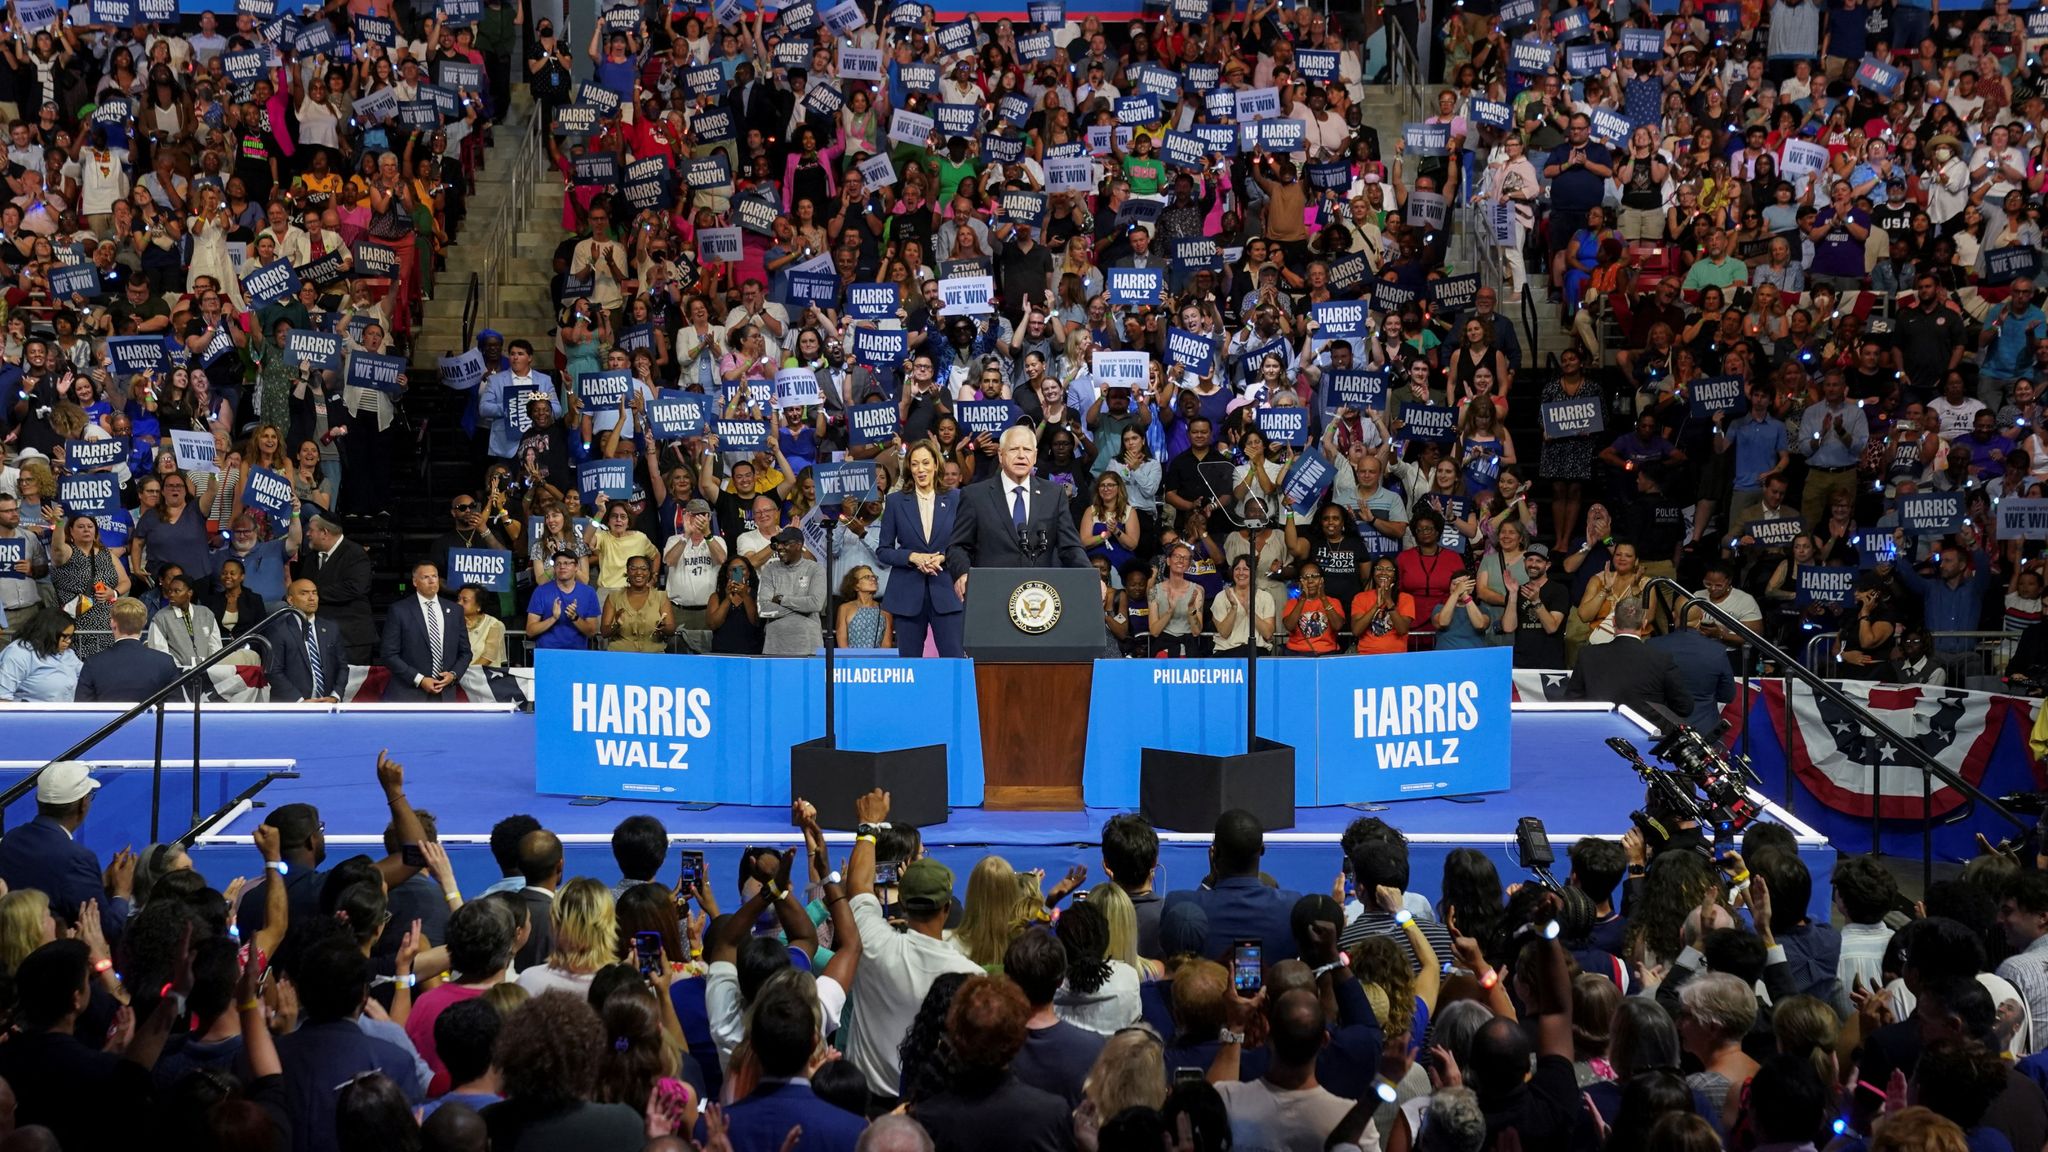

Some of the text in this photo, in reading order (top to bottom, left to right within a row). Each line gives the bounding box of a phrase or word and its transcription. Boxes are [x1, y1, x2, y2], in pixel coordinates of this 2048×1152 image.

[606, 9, 640, 22] HARRIS
[938, 24, 972, 44] HARRIS
[1018, 35, 1051, 52] HARRIS
[1624, 38, 1659, 52] WE WIN
[1025, 48, 1047, 59] WALZ
[1514, 45, 1550, 61] HARRIS
[224, 53, 261, 71] HARRIS
[843, 58, 878, 72] WE WIN
[1299, 55, 1335, 68] HARRIS
[1519, 58, 1543, 69] WALZ
[687, 68, 720, 88] HARRIS
[901, 68, 935, 82] HARRIS
[1188, 67, 1219, 81] HARRIS
[1304, 66, 1329, 77] WALZ
[906, 80, 930, 90] WALZ
[1142, 71, 1178, 88] HARRIS
[1194, 79, 1215, 88] WALZ
[1206, 93, 1234, 108] HARRIS
[1240, 98, 1275, 113] WE WIN
[560, 110, 596, 122] HARRIS
[938, 108, 974, 123] HARRIS
[1475, 103, 1509, 119] HARRIS
[1481, 112, 1504, 125] WALZ
[695, 113, 730, 133] HARRIS
[943, 120, 969, 131] WALZ
[1594, 111, 1629, 132] HARRIS
[703, 127, 727, 139] WALZ
[1262, 123, 1300, 139] HARRIS
[1597, 126, 1621, 141] WALZ
[986, 138, 1022, 154] HARRIS
[1166, 135, 1205, 157] HARRIS
[1268, 136, 1294, 147] WALZ
[1407, 134, 1445, 147] WE WIN
[991, 150, 1016, 161] WALZ
[1047, 143, 1082, 157] HARRIS
[1170, 150, 1196, 163] WALZ
[1050, 169, 1086, 184] WE WIN
[739, 199, 778, 222] HARRIS
[1003, 195, 1042, 212] HARRIS
[742, 214, 768, 229] WALZ
[1008, 209, 1034, 220] WALZ
[1882, 218, 1910, 230] USA
[359, 245, 396, 264] HARRIS
[702, 239, 737, 255] WE WIN
[1177, 240, 1216, 258] HARRIS
[366, 261, 390, 272] WALZ
[1184, 256, 1212, 266] WALZ
[53, 274, 93, 294] WE WIN
[248, 264, 290, 298] HARRIS
[1113, 273, 1157, 289] HARRIS
[260, 281, 288, 301] WALZ
[792, 283, 833, 300] WE WIN
[852, 288, 894, 305] HARRIS
[945, 288, 988, 305] WE WIN
[1120, 289, 1150, 299] WALZ
[1435, 278, 1477, 300] HARRIS
[1443, 294, 1471, 307] WALZ
[859, 304, 888, 314] WALZ
[1318, 306, 1362, 324] HARRIS
[1326, 321, 1356, 333] WALZ
[290, 334, 336, 354] HARRIS
[858, 333, 902, 352] HARRIS
[1169, 333, 1209, 360] HARRIS
[116, 344, 162, 361] HARRIS
[296, 351, 327, 364] WALZ
[865, 350, 895, 362] WALZ
[1172, 352, 1199, 368] WALZ
[127, 357, 158, 369] WALZ
[355, 363, 397, 384] WE WIN
[1100, 364, 1143, 378] WE WIN
[582, 376, 629, 396] HARRIS
[777, 380, 818, 398] WE WIN
[1334, 375, 1382, 392] HARRIS
[1695, 380, 1740, 402] HARRIS
[590, 394, 622, 405] WALZ
[1341, 392, 1373, 403] WALZ
[1704, 398, 1735, 409] WALZ
[653, 403, 701, 422] HARRIS
[854, 407, 897, 429] HARRIS
[963, 405, 1009, 422] HARRIS
[1404, 409, 1453, 427] HARRIS
[1550, 403, 1596, 423] HARRIS
[663, 421, 695, 432] WALZ
[718, 420, 766, 436] HARRIS
[971, 422, 1002, 432] WALZ
[1260, 414, 1302, 429] HARRIS
[1558, 419, 1590, 430] WALZ
[863, 424, 893, 438] WALZ
[1266, 430, 1295, 439] WALZ
[1412, 425, 1444, 437] WALZ
[727, 434, 759, 445] WALZ
[72, 441, 122, 458] HARRIS
[80, 455, 114, 465] WALZ
[820, 470, 838, 478] WHEN
[61, 480, 112, 500] HARRIS
[251, 472, 292, 500] HARRIS
[583, 473, 626, 492] WE WIN
[820, 474, 870, 494] WE WIN
[69, 500, 105, 510] WALZ
[255, 492, 283, 510] WALZ
[1904, 498, 1957, 518] HARRIS
[1655, 507, 1679, 518] POLICE
[1913, 518, 1949, 528] WALZ
[1318, 547, 1354, 560] HARRIS
[454, 554, 504, 574] HARRIS
[684, 557, 711, 566] HARRIS
[1329, 558, 1354, 568] 2024
[463, 573, 496, 584] WALZ
[692, 567, 703, 576] 47
[1801, 572, 1853, 591] HARRIS
[1810, 590, 1844, 602] WALZ
[825, 668, 915, 684] HILADELPHIA
[1153, 668, 1244, 685] PHILADELPHIA
[572, 682, 711, 739] HARRIS
[1353, 680, 1479, 739] HARRIS
[595, 739, 689, 770] WALZ
[1375, 737, 1460, 770] WALZ
